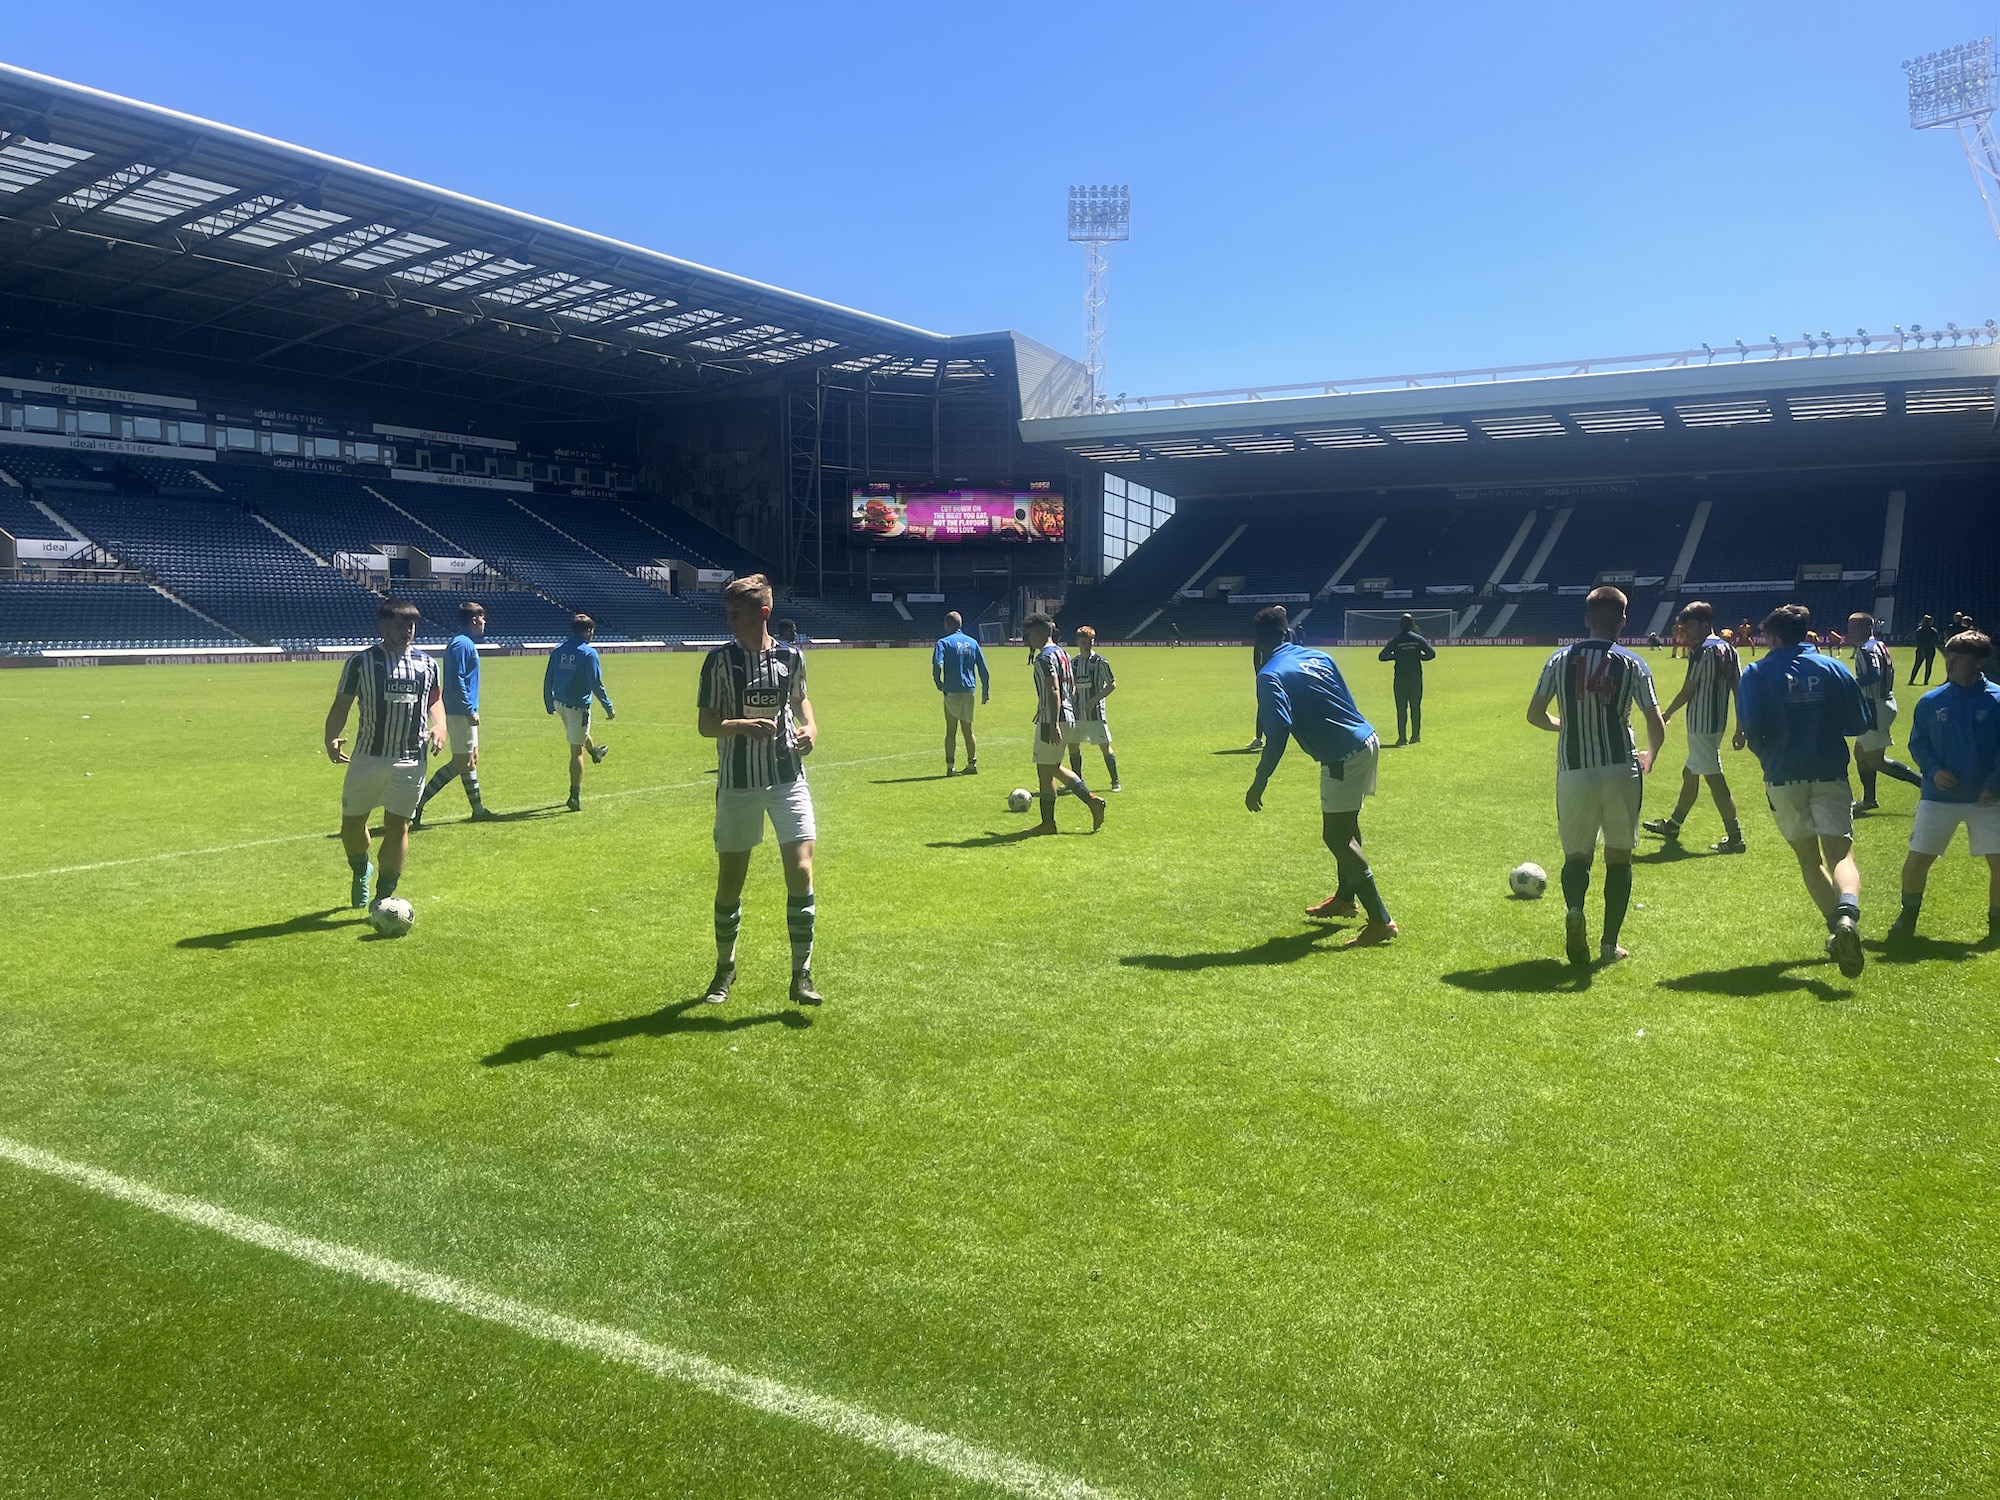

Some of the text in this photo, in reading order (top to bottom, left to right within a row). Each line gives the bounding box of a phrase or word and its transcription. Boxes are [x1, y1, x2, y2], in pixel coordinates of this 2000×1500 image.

[51, 384, 77, 396] ideal
[80, 389, 136, 401] HEATING
[254, 408, 276, 420] ideal
[278, 412, 324, 425] HEATING
[439, 433, 476, 444] HEATING
[69, 438, 155, 454] ideal HEATING
[570, 450, 602, 459] HEATING
[273, 458, 343, 473] ideal HEATING
[456, 477, 493, 487] HEATING
[587, 490, 618, 499] HEATING
[43, 542, 68, 552] ideal
[145, 657, 163, 666] CUT
[165, 656, 193, 665] DOWN
[195, 656, 208, 665] ON
[210, 656, 226, 664] THE
[228, 655, 251, 664] MEAT
[252, 654, 270, 663] YOU
[291, 654, 307, 662] NOT
[308, 653, 323, 661] THE
[1572, 655, 1614, 702] 14
[387, 681, 417, 693] ideal
[746, 691, 780, 705] ideal
